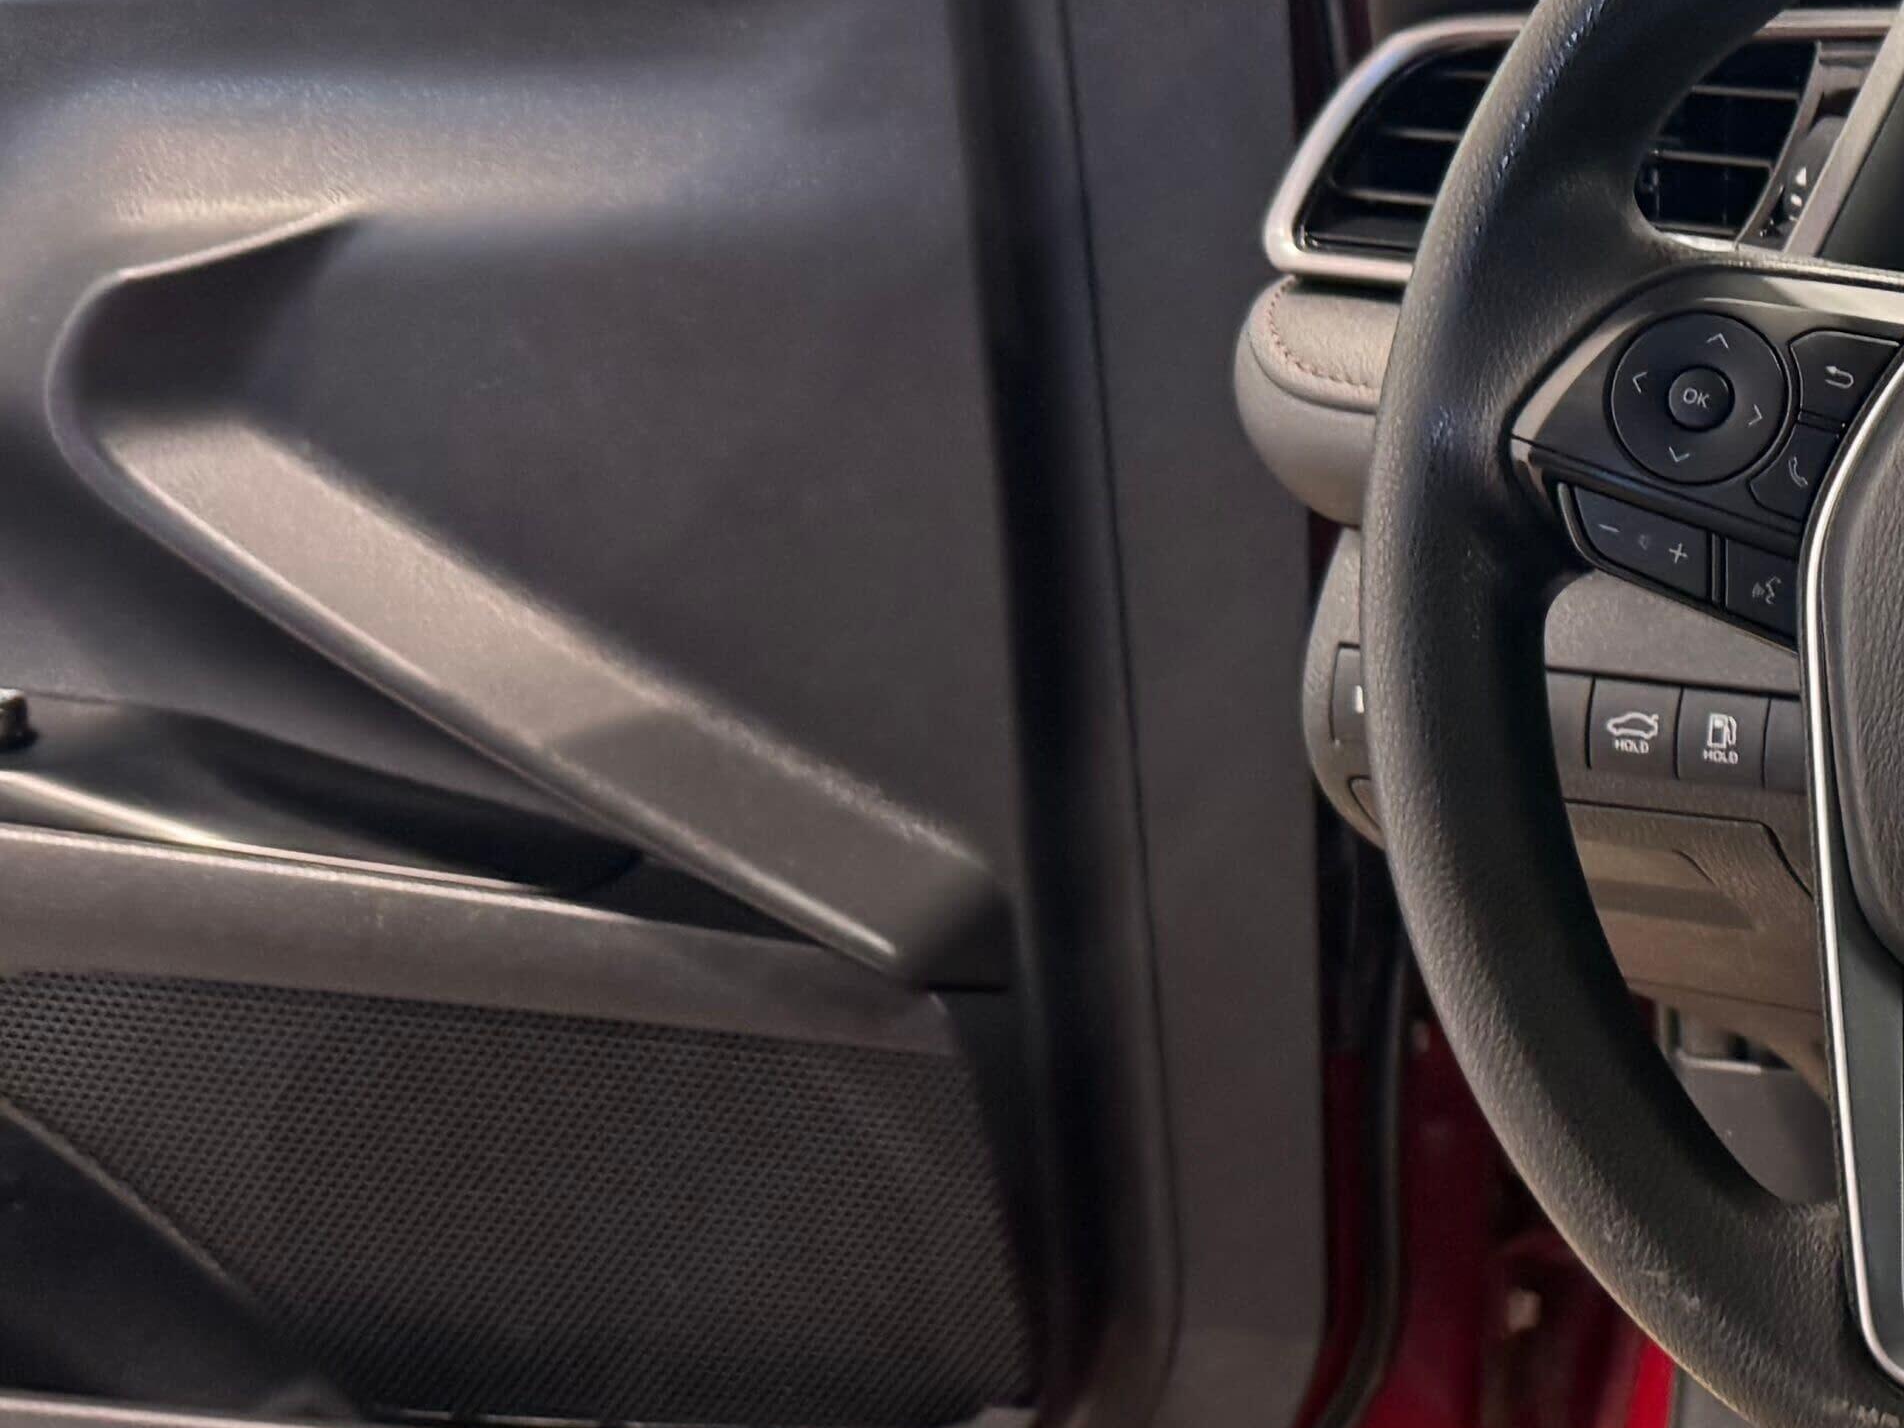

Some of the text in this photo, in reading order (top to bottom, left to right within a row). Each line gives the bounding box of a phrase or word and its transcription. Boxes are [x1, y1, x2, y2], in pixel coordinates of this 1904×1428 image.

[1682, 386, 1711, 409] OK
[1614, 738, 1650, 756] HOLD
[1703, 749, 1739, 767] HOLD
